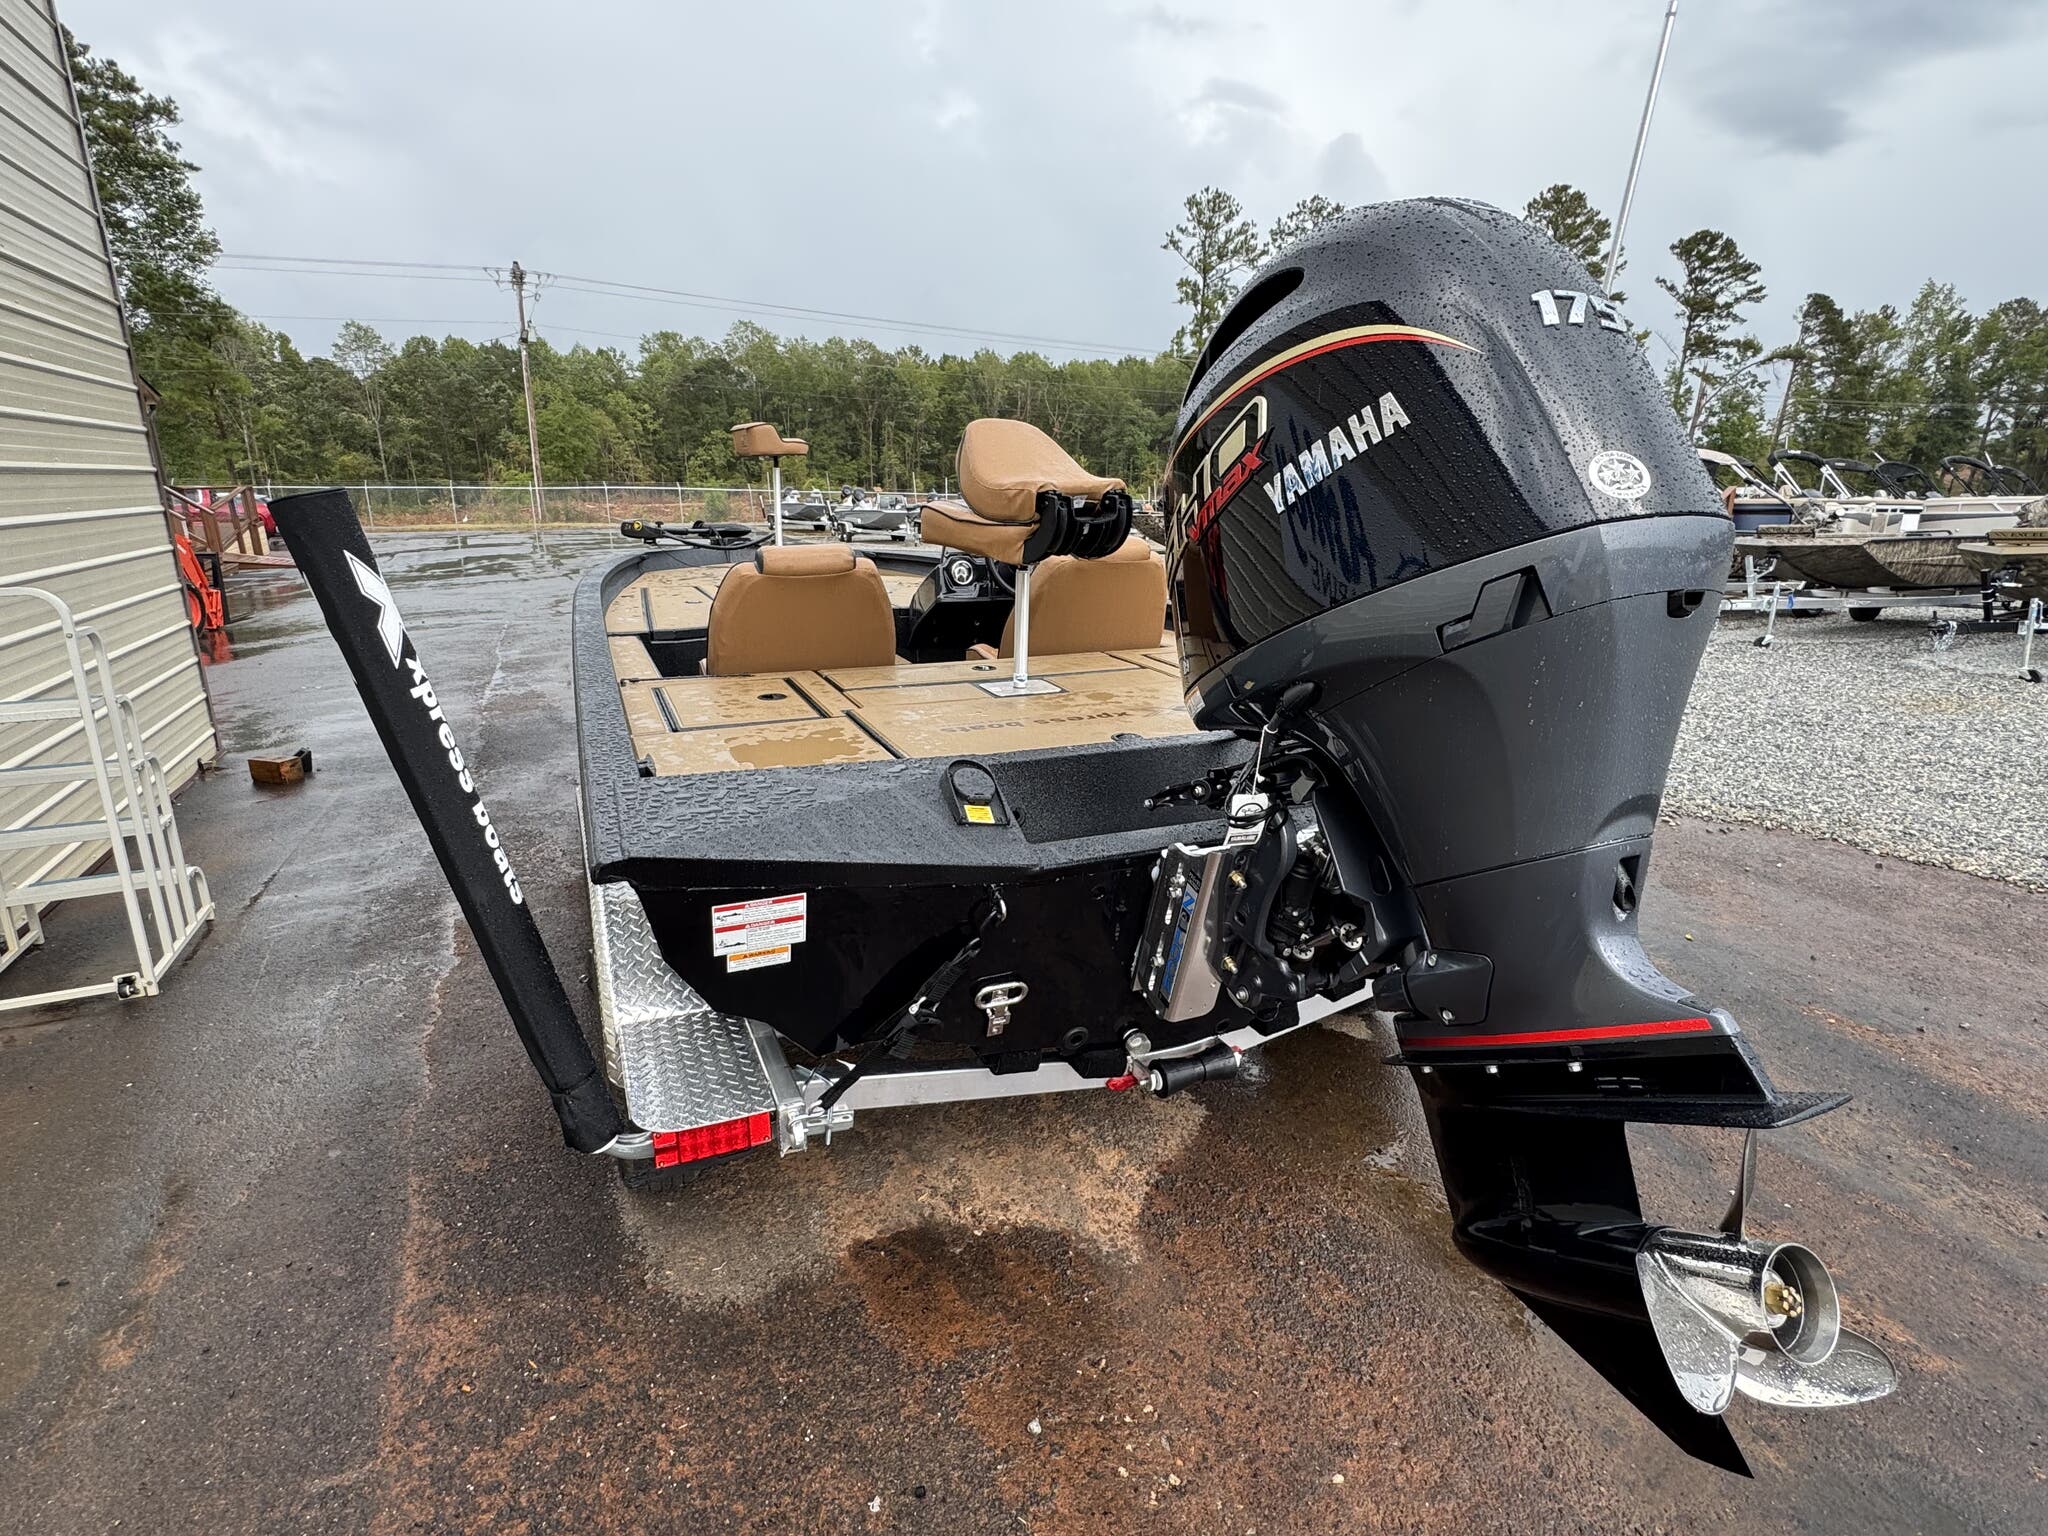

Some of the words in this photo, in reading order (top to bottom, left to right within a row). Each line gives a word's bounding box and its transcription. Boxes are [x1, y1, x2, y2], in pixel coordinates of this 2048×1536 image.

[1531, 289, 1628, 332] 175
[1263, 391, 1411, 514] YAMAHA
[939, 720, 1024, 734] boats
[1033, 710, 1130, 727] xpress
[405, 655, 475, 794] xpress
[471, 801, 525, 905] boats
